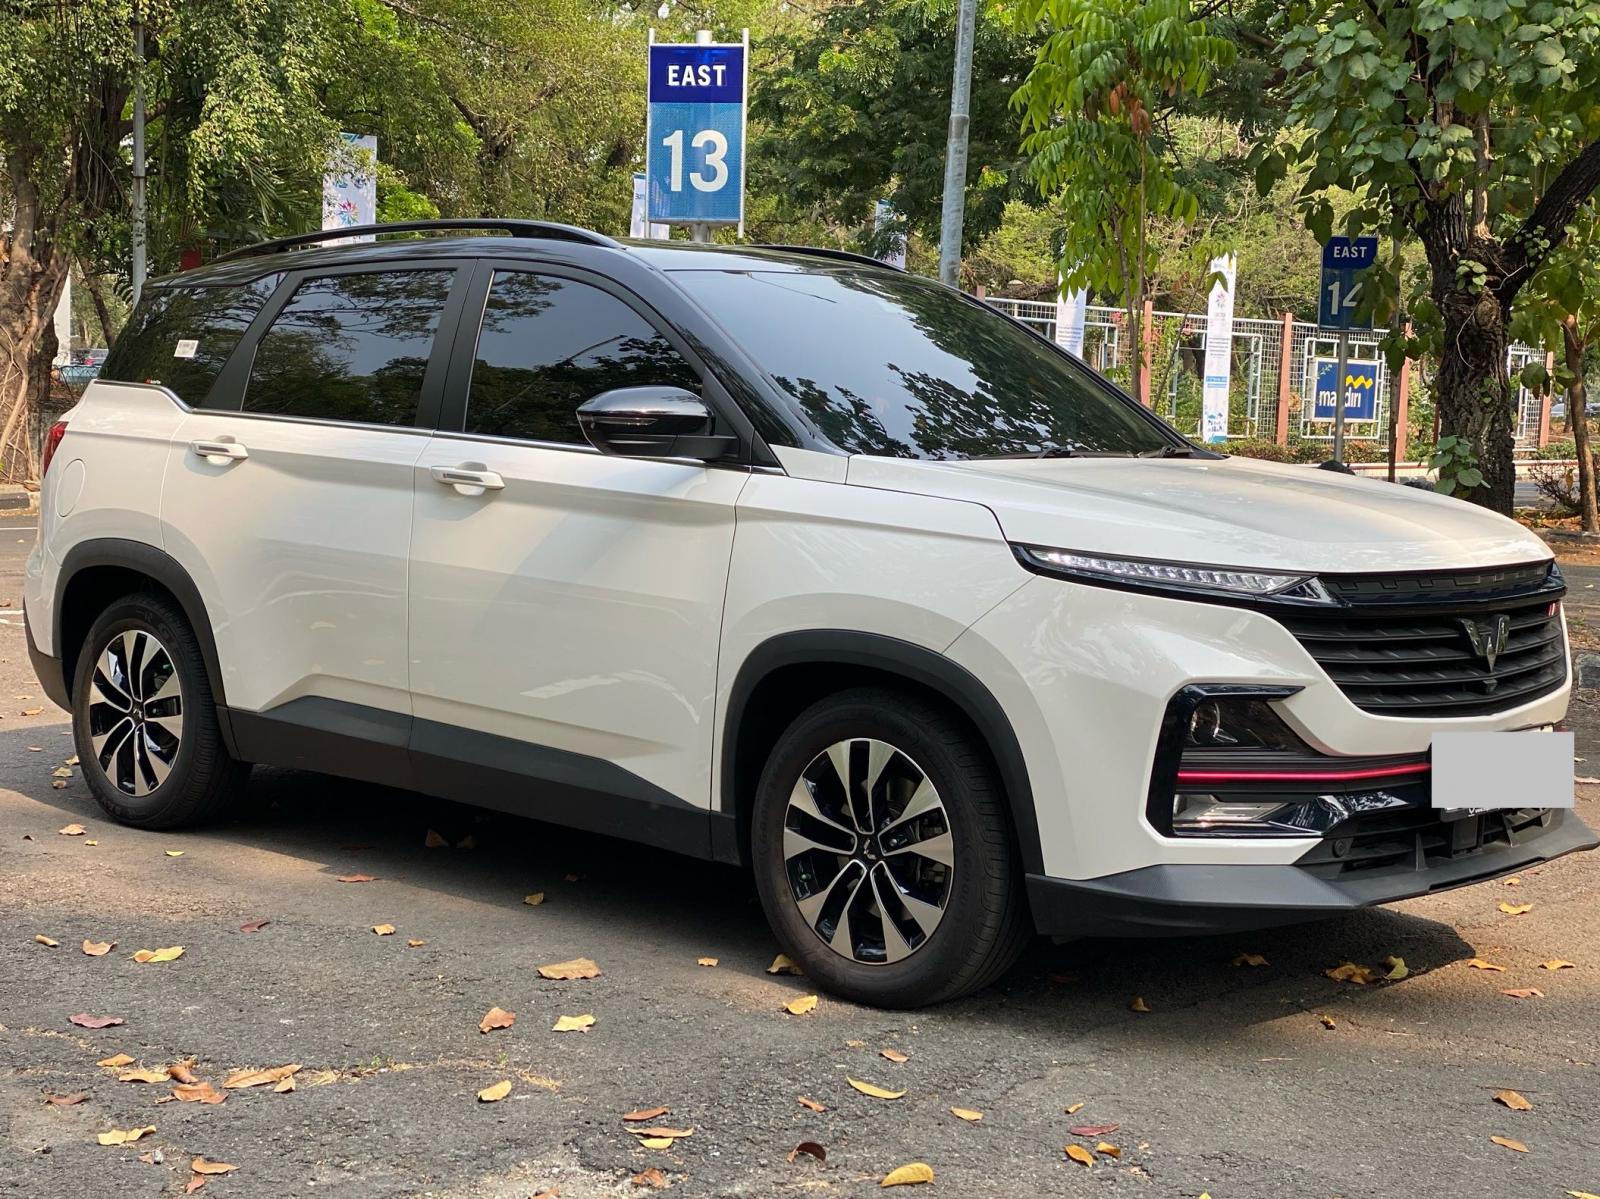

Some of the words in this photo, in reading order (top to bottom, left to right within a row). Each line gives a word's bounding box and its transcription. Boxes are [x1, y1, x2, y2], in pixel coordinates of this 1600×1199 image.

[668, 65, 727, 87] EAST
[662, 130, 729, 193] 13
[1333, 246, 1368, 258] EAST
[1319, 386, 1362, 408] madiri
